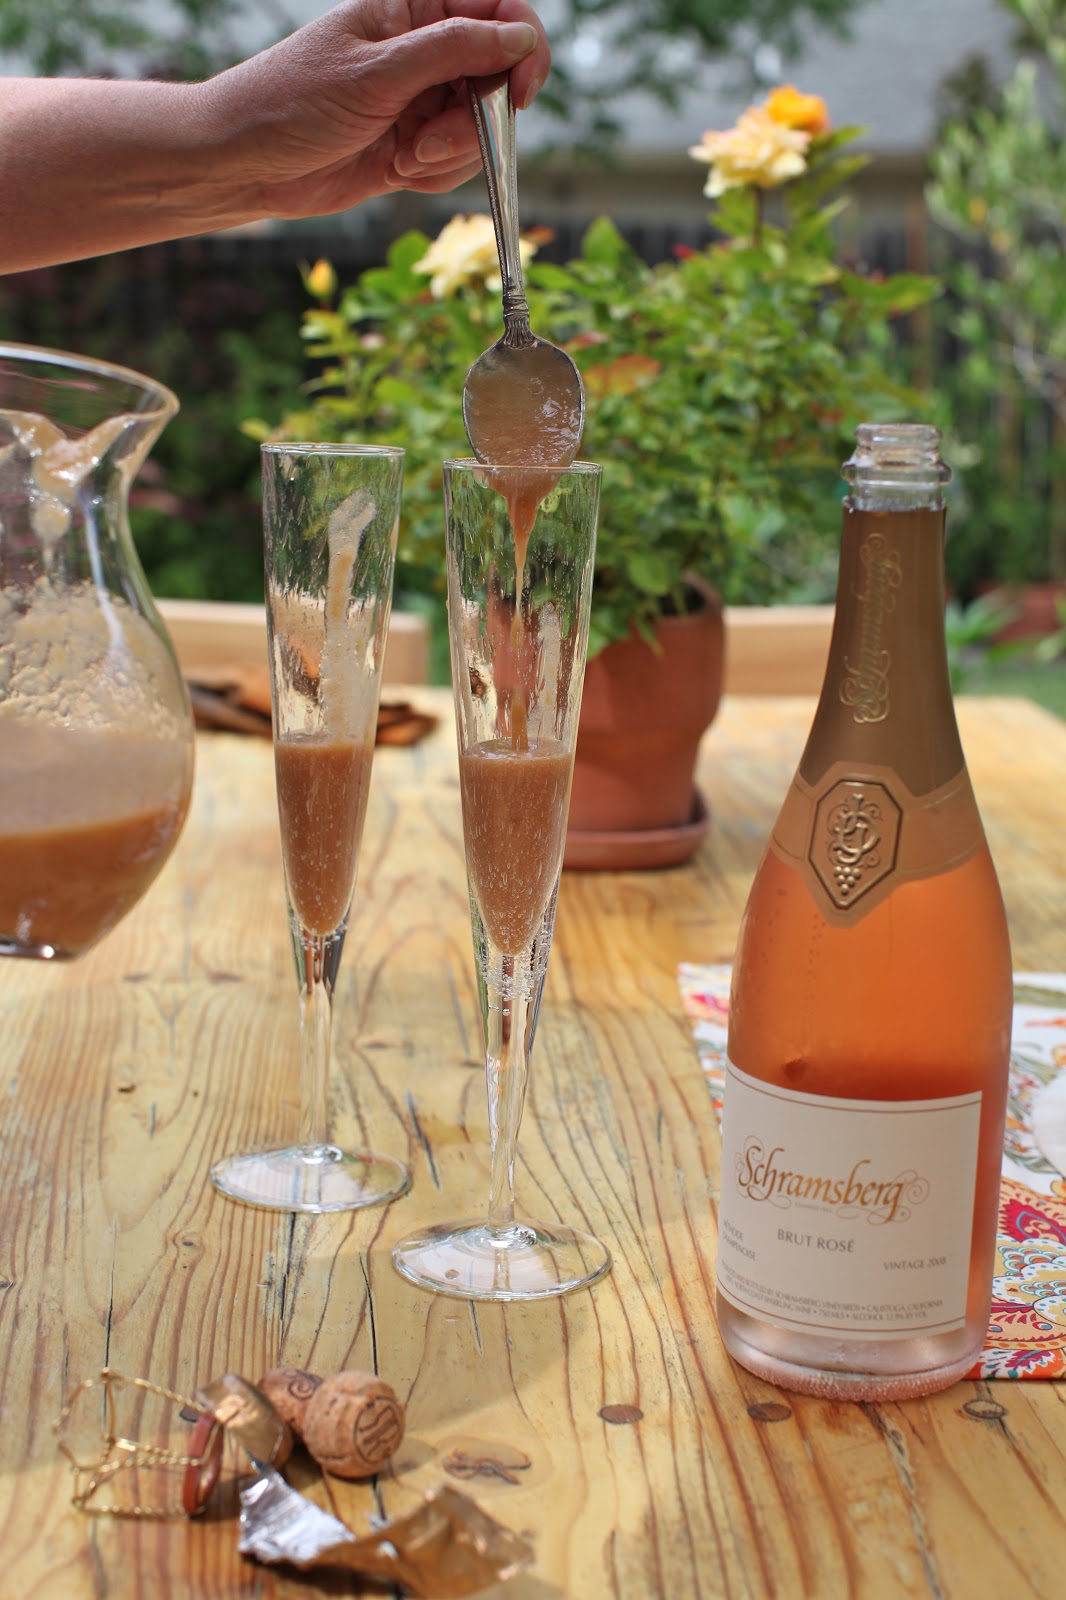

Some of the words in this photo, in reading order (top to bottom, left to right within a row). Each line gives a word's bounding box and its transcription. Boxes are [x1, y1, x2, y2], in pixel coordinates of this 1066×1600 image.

[735, 1139, 926, 1224] Schramsberg
[777, 1228, 812, 1247] BRUT
[816, 1238, 855, 1253] ROSÉ
[883, 1259, 925, 1271] VINTAGE
